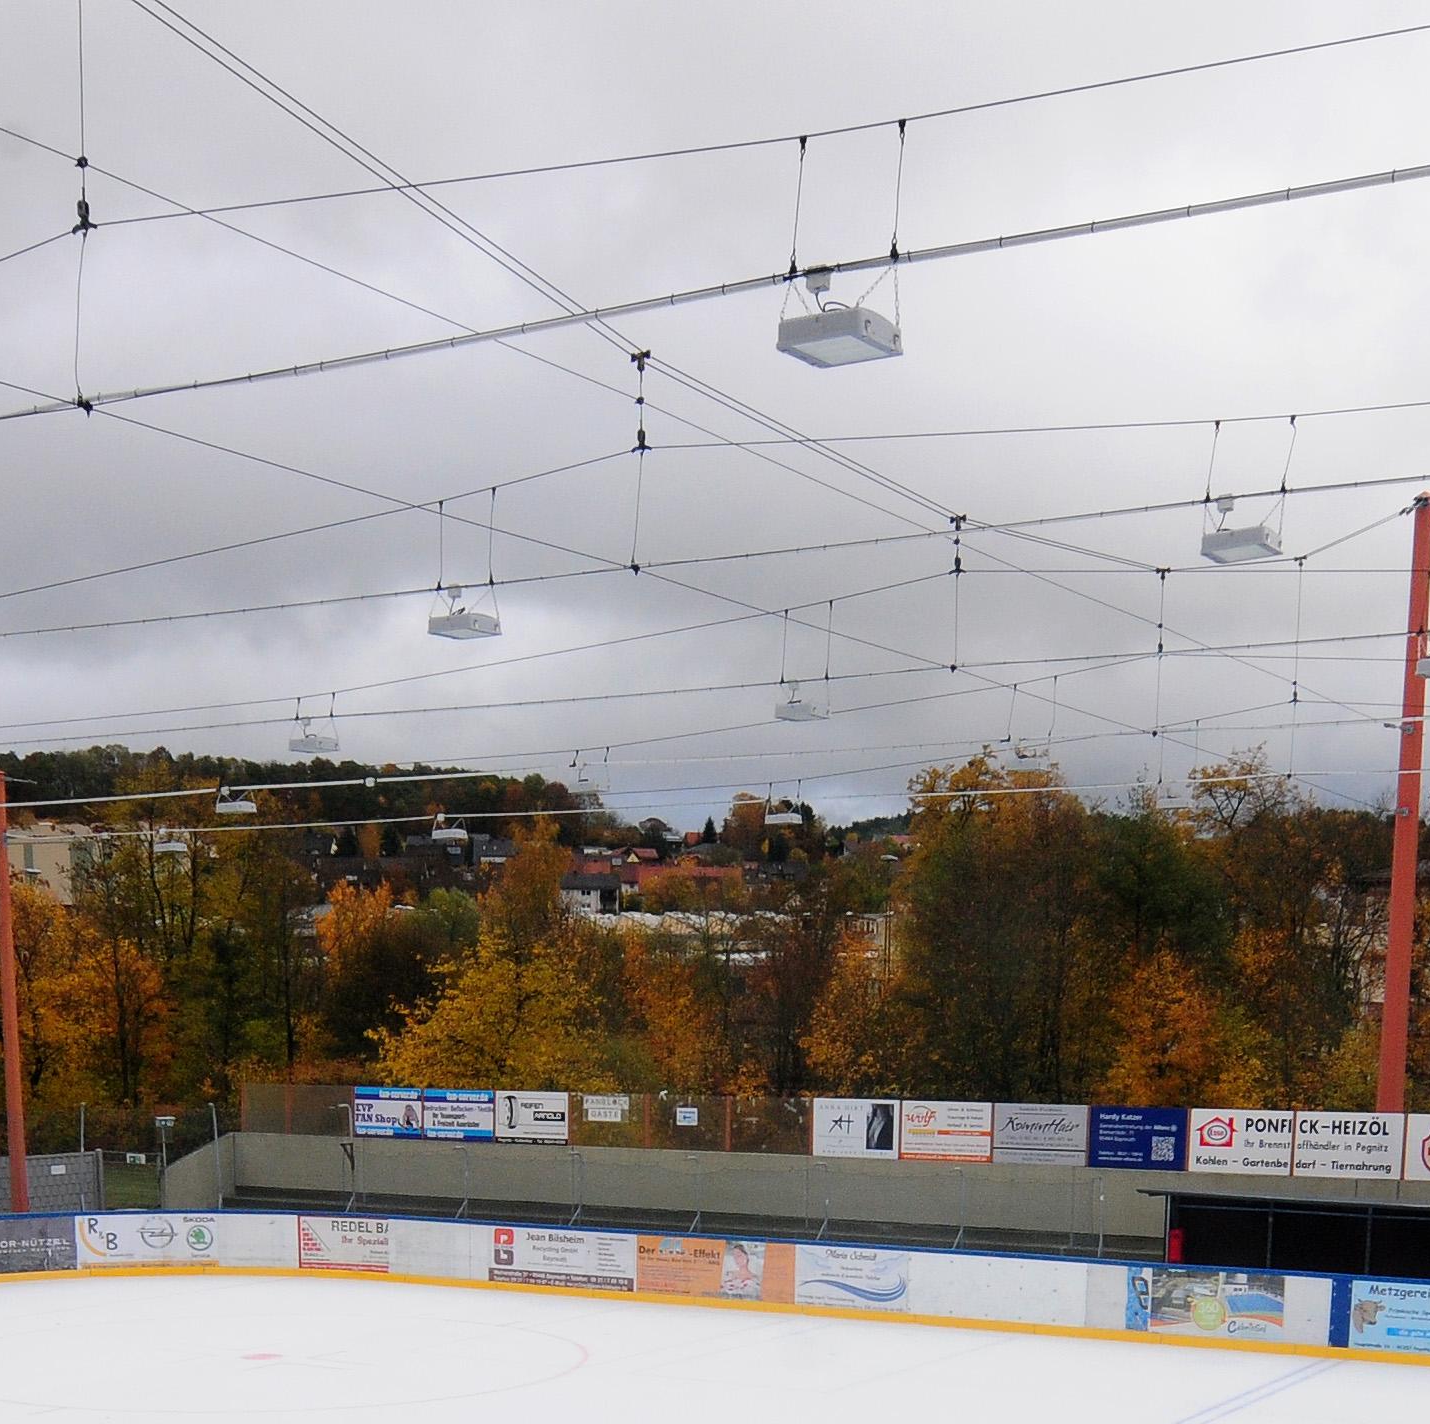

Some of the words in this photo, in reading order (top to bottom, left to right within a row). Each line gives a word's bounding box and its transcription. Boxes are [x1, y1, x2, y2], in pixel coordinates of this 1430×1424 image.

[375, 1114, 397, 1126] Shop
[1344, 1142, 1352, 1151] in
[1356, 1143, 1389, 1154] Pegnitz
[1195, 1156, 1228, 1166] Kohlen
[1331, 1161, 1392, 1174] Tiernahrung
[331, 1220, 372, 1234] REDEL
[88, 1217, 99, 1234] R
[106, 1232, 118, 1250] B
[526, 1232, 546, 1242] Jean
[639, 1245, 655, 1255] Der
